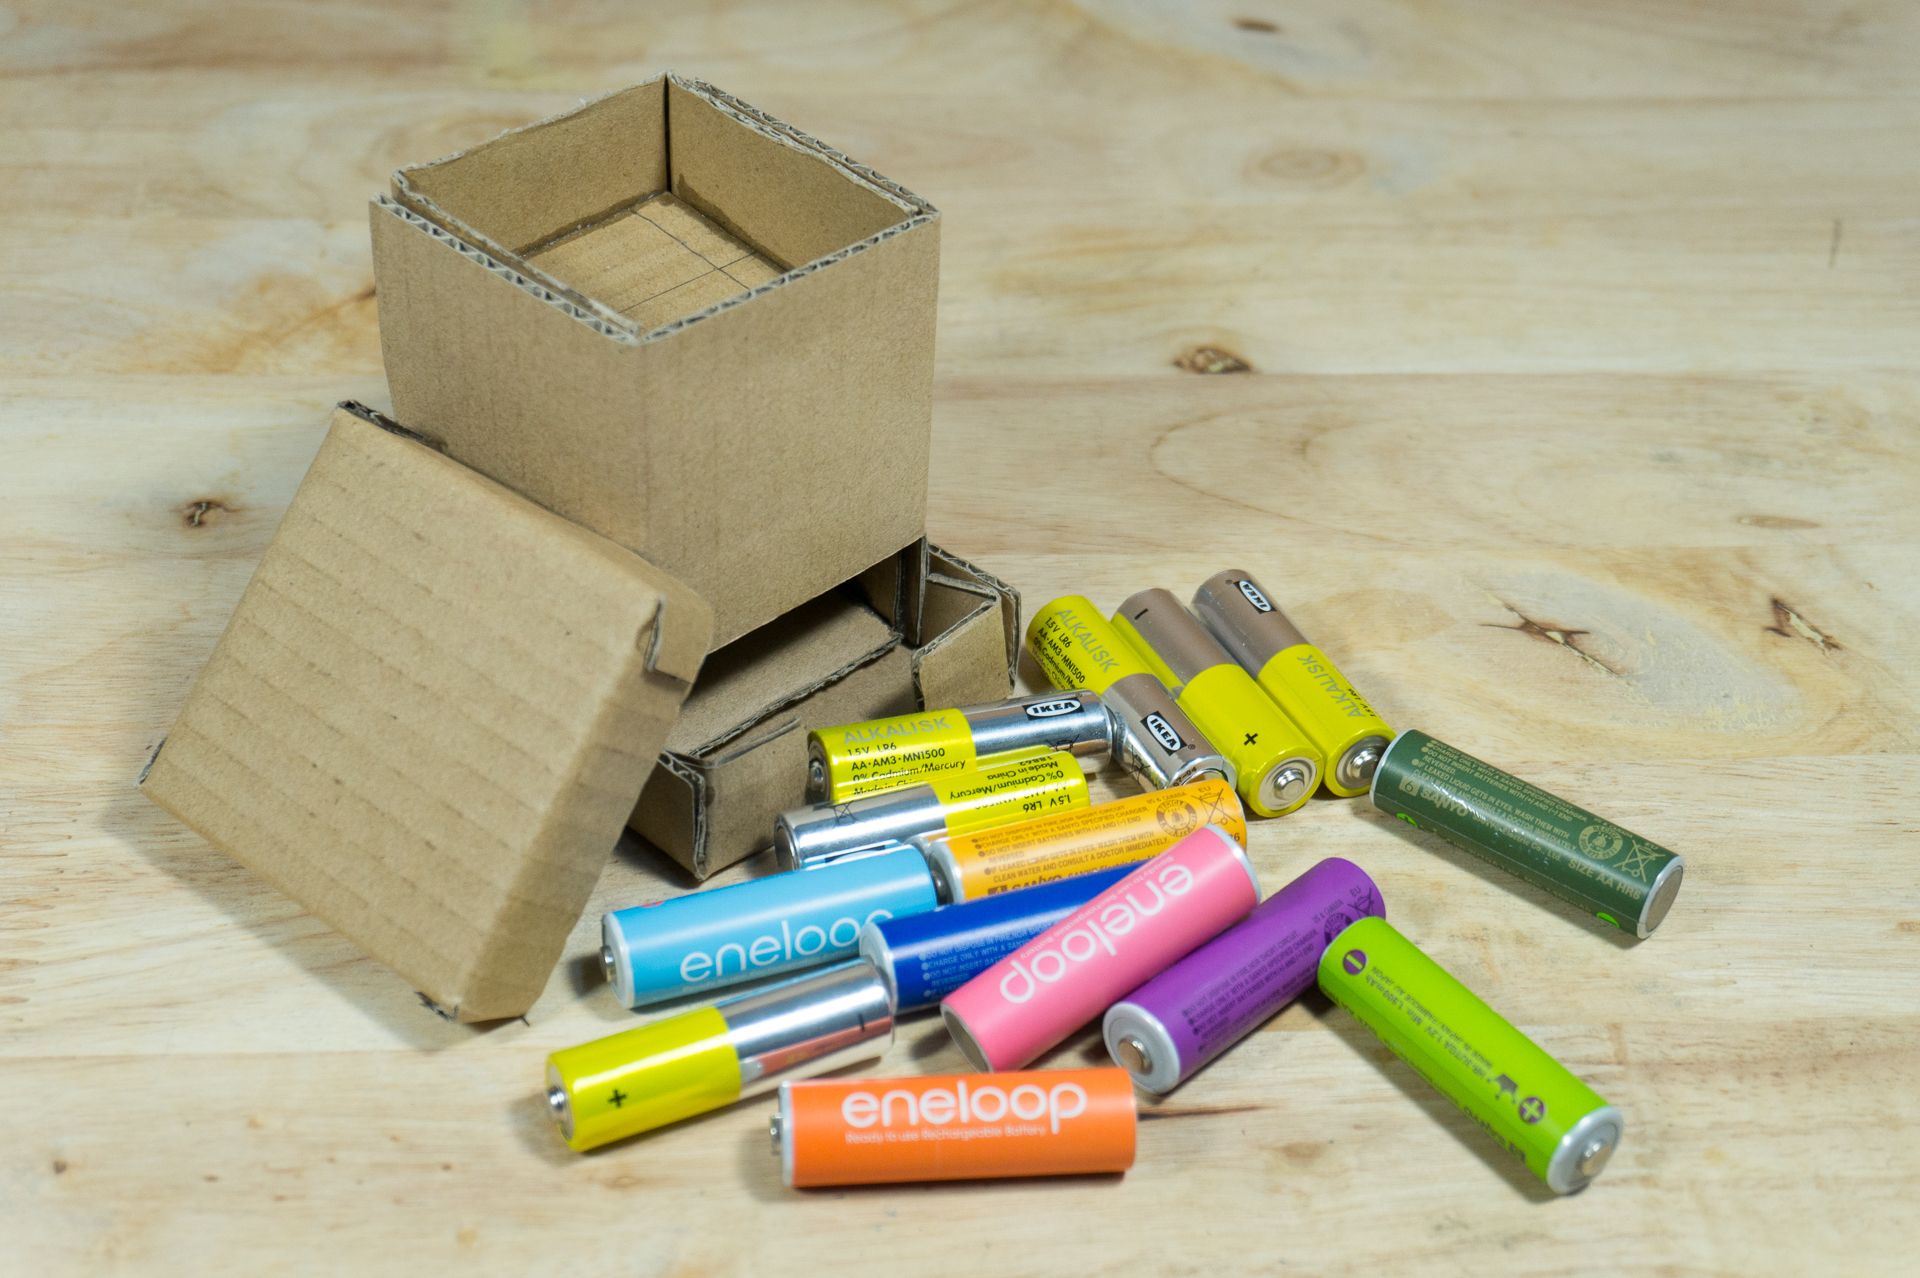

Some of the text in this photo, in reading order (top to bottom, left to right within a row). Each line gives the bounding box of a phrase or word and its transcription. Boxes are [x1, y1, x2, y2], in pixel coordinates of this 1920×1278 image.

[1055, 609, 1119, 673] ALKALISK
[1059, 629, 1072, 648] LR6
[1297, 655, 1366, 717] ALKALISK
[1032, 700, 1076, 714] IKEA
[843, 714, 952, 742] ALKALISK
[1150, 718, 1177, 748] IKEA
[987, 769, 1016, 782] China
[1028, 760, 1057, 772] Made
[1045, 769, 1064, 781] 0%
[950, 774, 1046, 801] Cadmium/Mercury
[1022, 801, 1043, 814] LR6
[1419, 788, 1468, 819] SANYO
[1568, 860, 1641, 900] SIZE AA HR6
[1000, 864, 1194, 1003] eneloop
[841, 1079, 1088, 1134] eneloop
[1005, 1123, 1046, 1138] Battery
